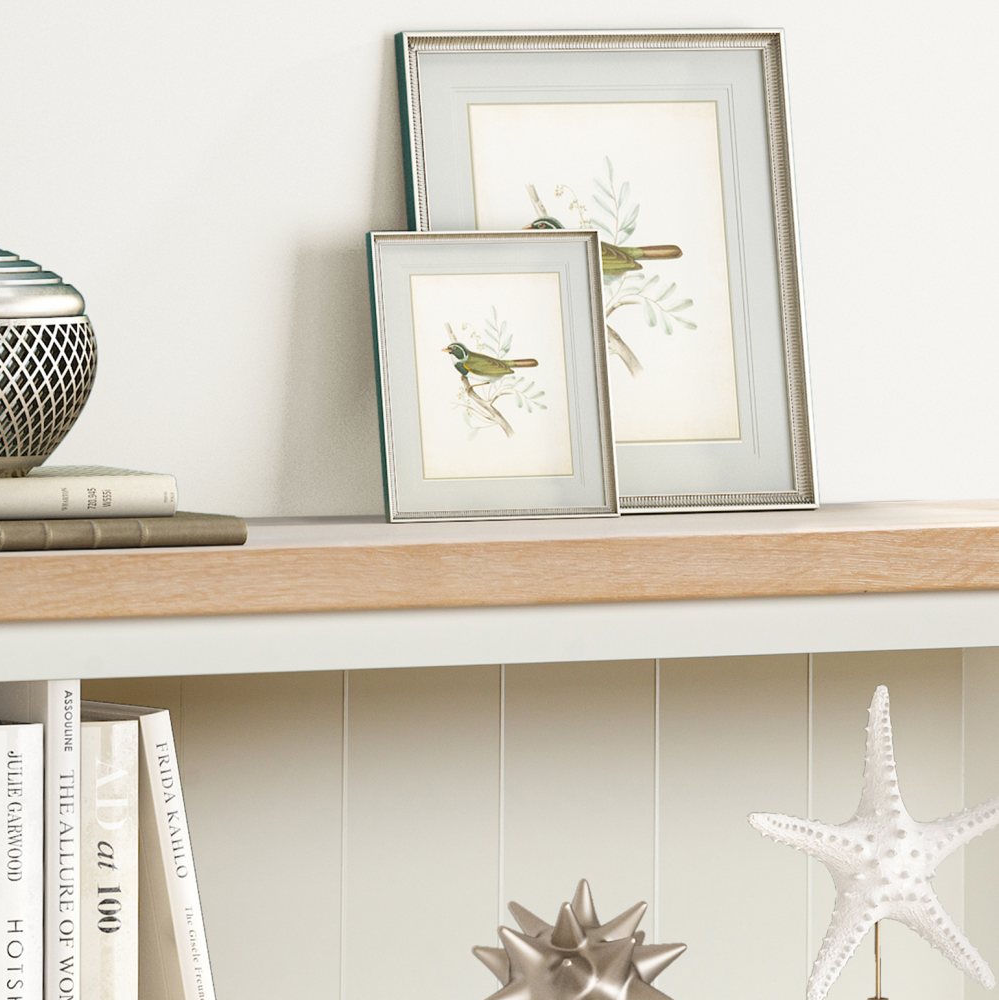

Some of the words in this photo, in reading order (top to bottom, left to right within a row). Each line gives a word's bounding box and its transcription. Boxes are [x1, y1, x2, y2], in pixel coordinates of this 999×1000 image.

[64, 690, 73, 752] ASSOULINE
[7, 750, 22, 798] JULIE
[59, 769, 74, 815] THE
[96, 760, 131, 831] AD
[155, 742, 177, 804] FRIDA
[167, 811, 189, 879] KAHLO
[7, 801, 23, 882] GARWOOD
[59, 821, 74, 912] ALLURE
[97, 840, 118, 871] at
[59, 919, 74, 947] OF
[97, 883, 123, 933] 100
[184, 906, 194, 926] The
